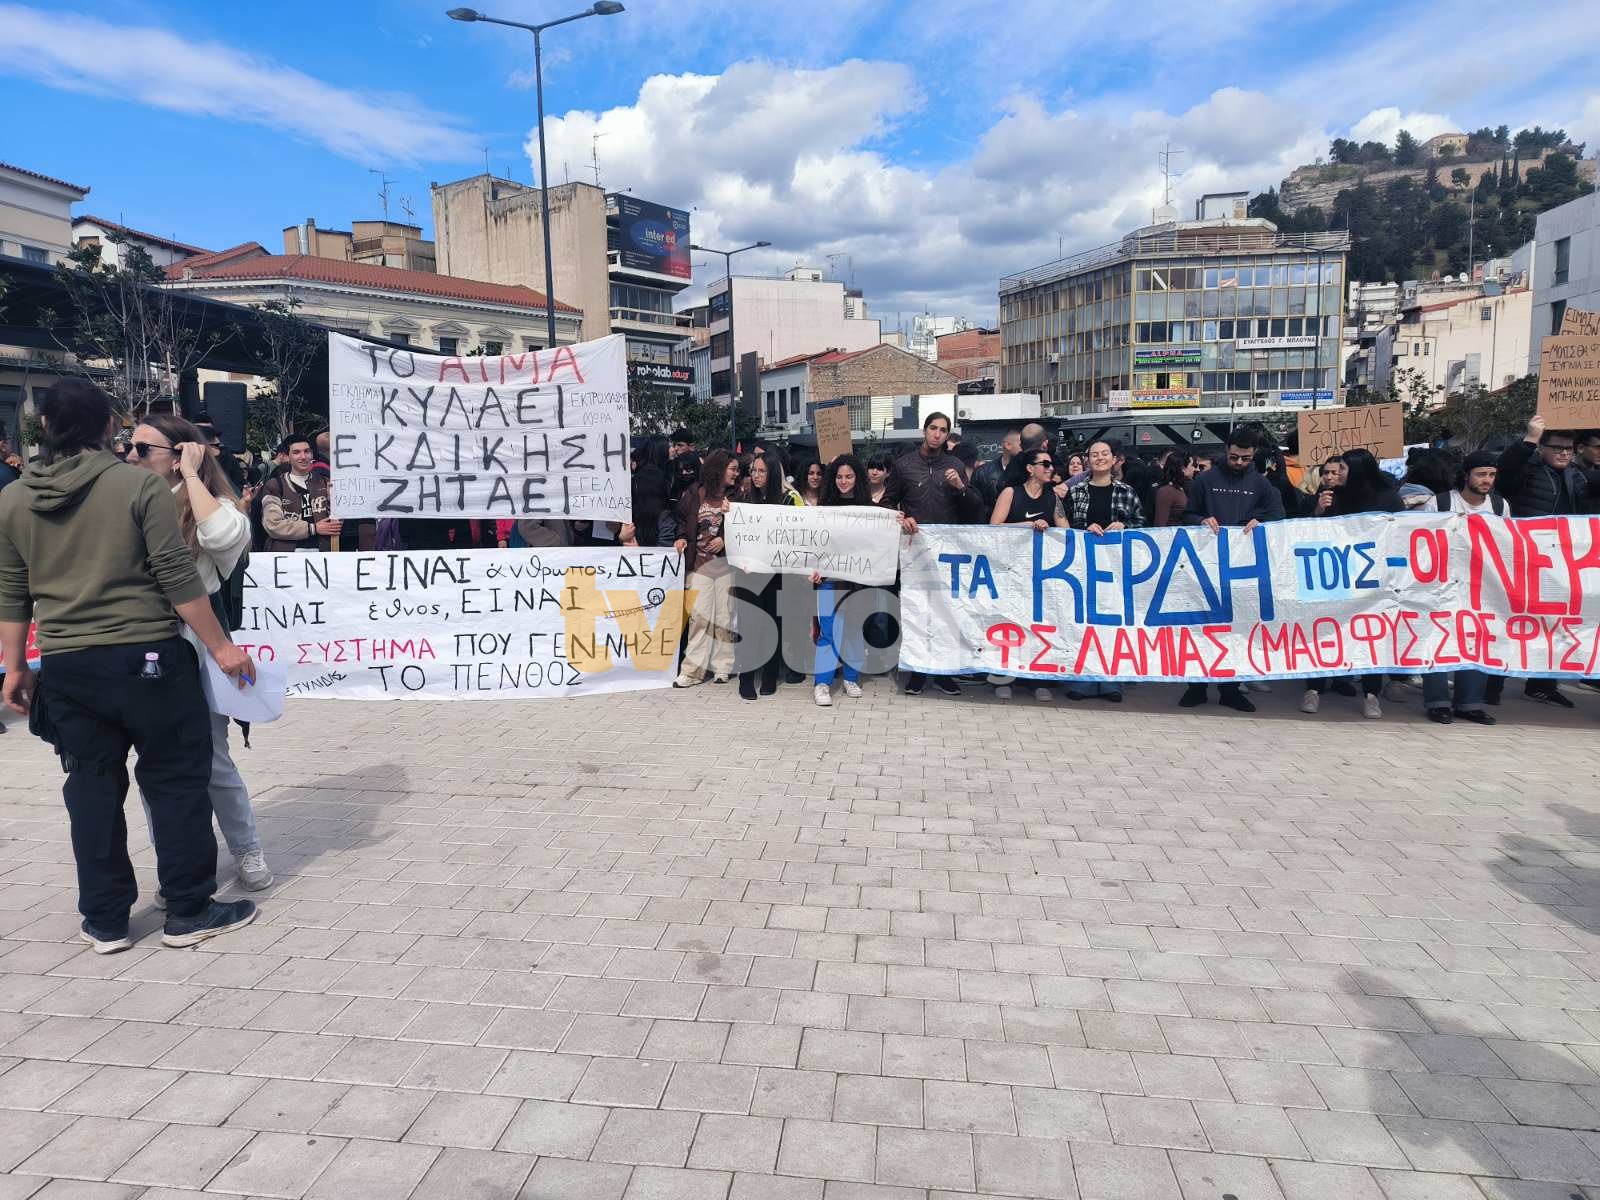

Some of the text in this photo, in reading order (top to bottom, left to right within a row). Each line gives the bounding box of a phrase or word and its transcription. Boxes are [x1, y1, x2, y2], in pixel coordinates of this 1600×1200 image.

[361, 345, 585, 384] ΤΟ ΑΙΜΑ
[380, 385, 565, 430] ΚΥΛΑΕΙ
[1308, 406, 1391, 434] ΣΤΕΙΛΕ
[334, 431, 627, 473] ΕΚΔΙΚΗΣΗ
[377, 475, 570, 515] ΖΗΤΑΕΙ
[731, 506, 762, 525] Δεν
[766, 528, 830, 548] ΚΡΑΤΙΚΟ
[356, 553, 471, 592] ΕΙΝΑΙ
[616, 552, 682, 579] ΔΕΝ
[770, 549, 873, 576] ΔΥΣΤΥΧΗΜΑ
[938, 552, 999, 600] ΤΑ
[1032, 525, 1276, 627] ΚΕΡΔΗ
[461, 586, 584, 615] ΕΙΝΑΙ
[297, 637, 436, 665] ΣΥΣΤΗΜΑ
[453, 633, 515, 659] ΠΟΥ
[529, 627, 675, 660] ΓΕΝΝΗΣΕ
[986, 622, 1067, 674] Φ.Σ.
[1073, 625, 1236, 678] ΛΑΜΙΑΣ
[368, 661, 584, 692] ΤΟ ΠΕΝΘΟΣ
